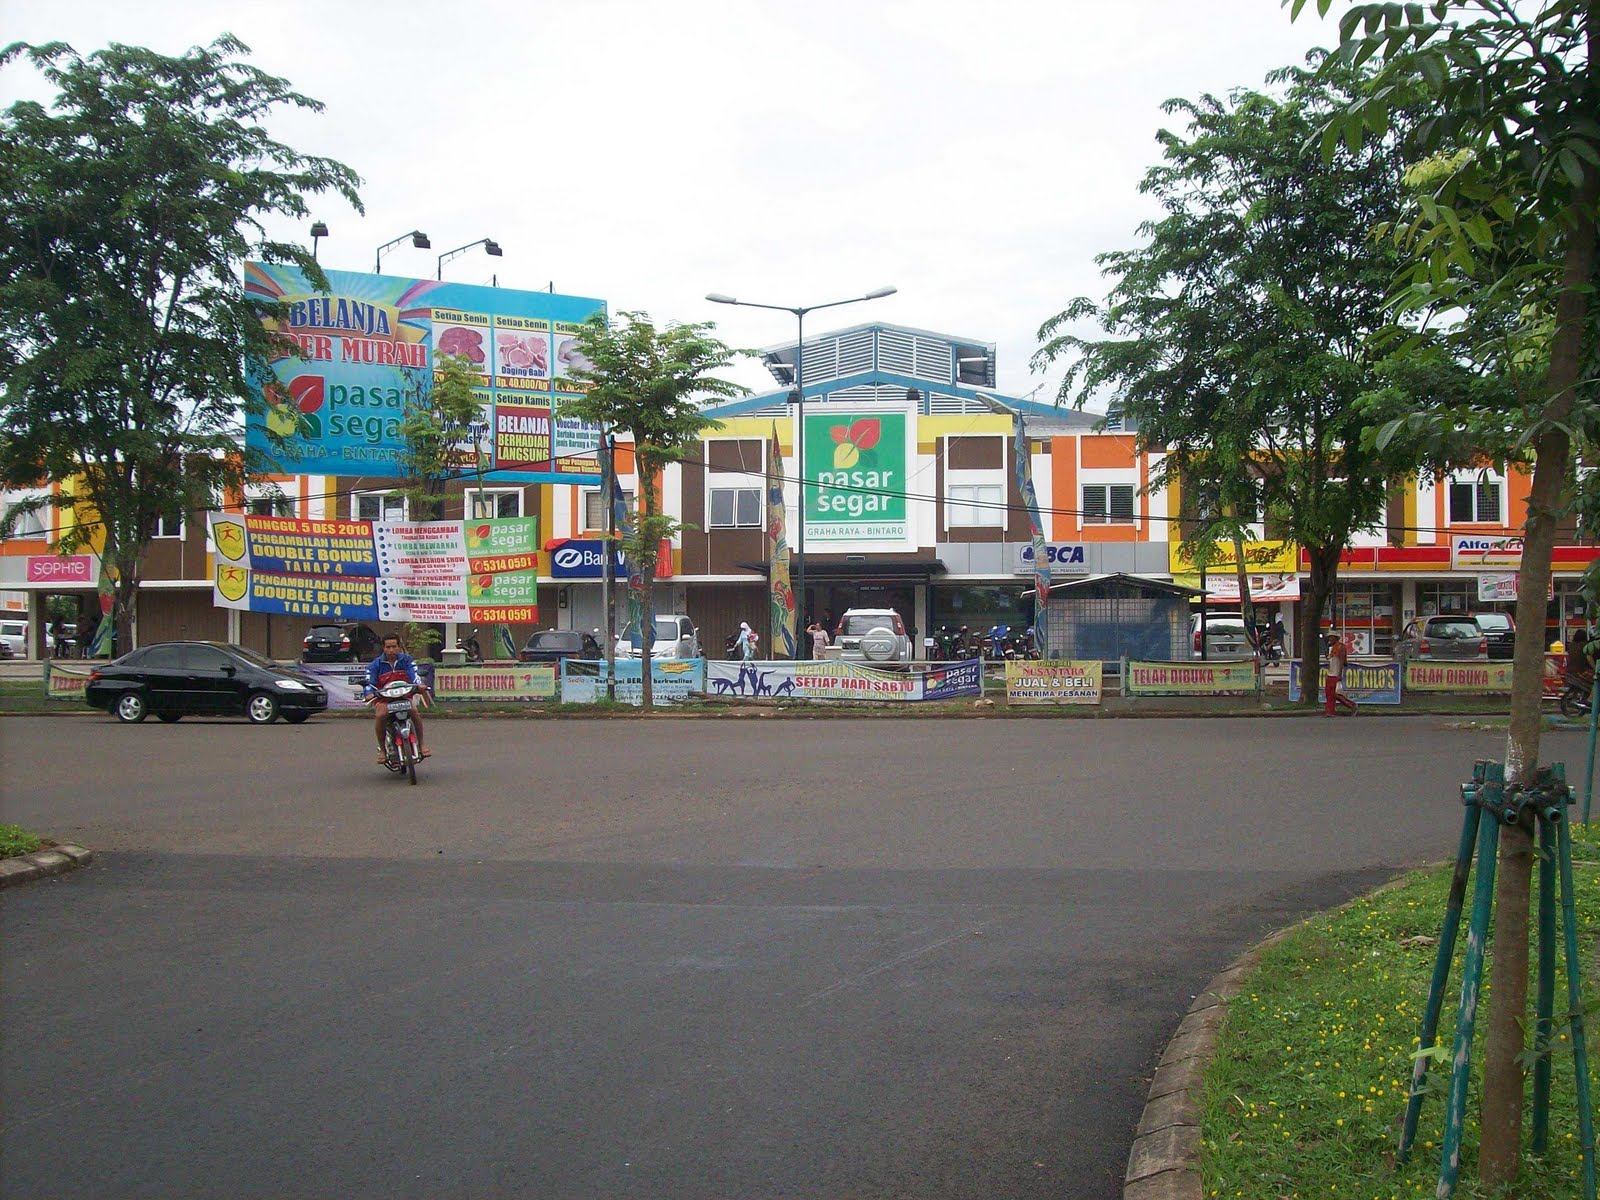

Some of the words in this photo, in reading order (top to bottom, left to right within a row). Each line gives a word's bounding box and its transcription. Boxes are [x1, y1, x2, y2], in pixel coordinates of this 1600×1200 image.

[289, 297, 391, 336] BELANJA
[434, 311, 462, 322] Setiap
[464, 313, 488, 324] Senin
[496, 316, 522, 329] Setiap
[524, 319, 548, 330] Senin
[341, 336, 427, 368] MURAH
[501, 366, 527, 377] Daging
[528, 367, 545, 378] Babi
[496, 377, 507, 388] Rp.
[497, 393, 524, 405] Setiap
[525, 395, 550, 406] Kamis
[329, 414, 408, 443] sega
[498, 415, 549, 434] BELANJA
[497, 433, 549, 448] BERHADIAH
[497, 447, 549, 462] LANGSUNG
[818, 470, 893, 493] pasar
[817, 493, 893, 517] segar
[247, 518, 299, 533] MINGGU,
[302, 522, 310, 533] 5
[313, 523, 336, 534] DES
[339, 524, 369, 536] 2010
[392, 527, 413, 535] LOMBA
[414, 526, 459, 534] MENGGAMBAR
[492, 523, 530, 536] pasar
[807, 527, 837, 536] GRAHA
[838, 527, 860, 535] RAYA
[867, 527, 904, 535] BINTARO
[250, 533, 328, 548] PENGAMBILAN
[331, 538, 373, 550] HADIAH
[491, 534, 529, 547] segar
[252, 544, 314, 560] DOUBLE
[318, 549, 373, 563] BONUS
[584, 550, 610, 565] Ban
[1046, 546, 1084, 563] BCA
[285, 560, 330, 574] TAHAP
[334, 563, 343, 574] 4
[483, 559, 507, 572] 5314
[508, 557, 531, 570] 0591
[253, 574, 329, 590] PENGAMBILAN
[331, 579, 375, 593] HADIAH
[494, 575, 532, 587] pasar
[254, 585, 314, 602] DOUBLE
[317, 591, 374, 606] BONUS
[493, 586, 532, 598] segar
[284, 601, 330, 615] TAHAP
[334, 605, 341, 616] 4
[483, 609, 507, 621] 5314
[508, 608, 531, 620] 0591
[794, 662, 850, 677] Aerobik
[946, 665, 977, 679] pasar
[1023, 667, 1085, 676] NUSANTARA
[1133, 668, 1167, 684] TELAH
[1170, 668, 1214, 684] DIBUKA
[1409, 667, 1443, 684] TELAH
[1446, 668, 1489, 684] DIBUKA
[437, 675, 470, 690] TELAH
[473, 675, 515, 690] DIBUKA
[795, 676, 838, 688] SETIAP
[841, 678, 870, 690] HARI
[874, 680, 914, 692] SABTU
[946, 674, 977, 686] segar
[1015, 678, 1047, 687] JUAL
[1052, 678, 1060, 687] &
[1065, 678, 1093, 687] BELI
[1346, 668, 1360, 689] ON
[1362, 668, 1395, 689] KILO'S
